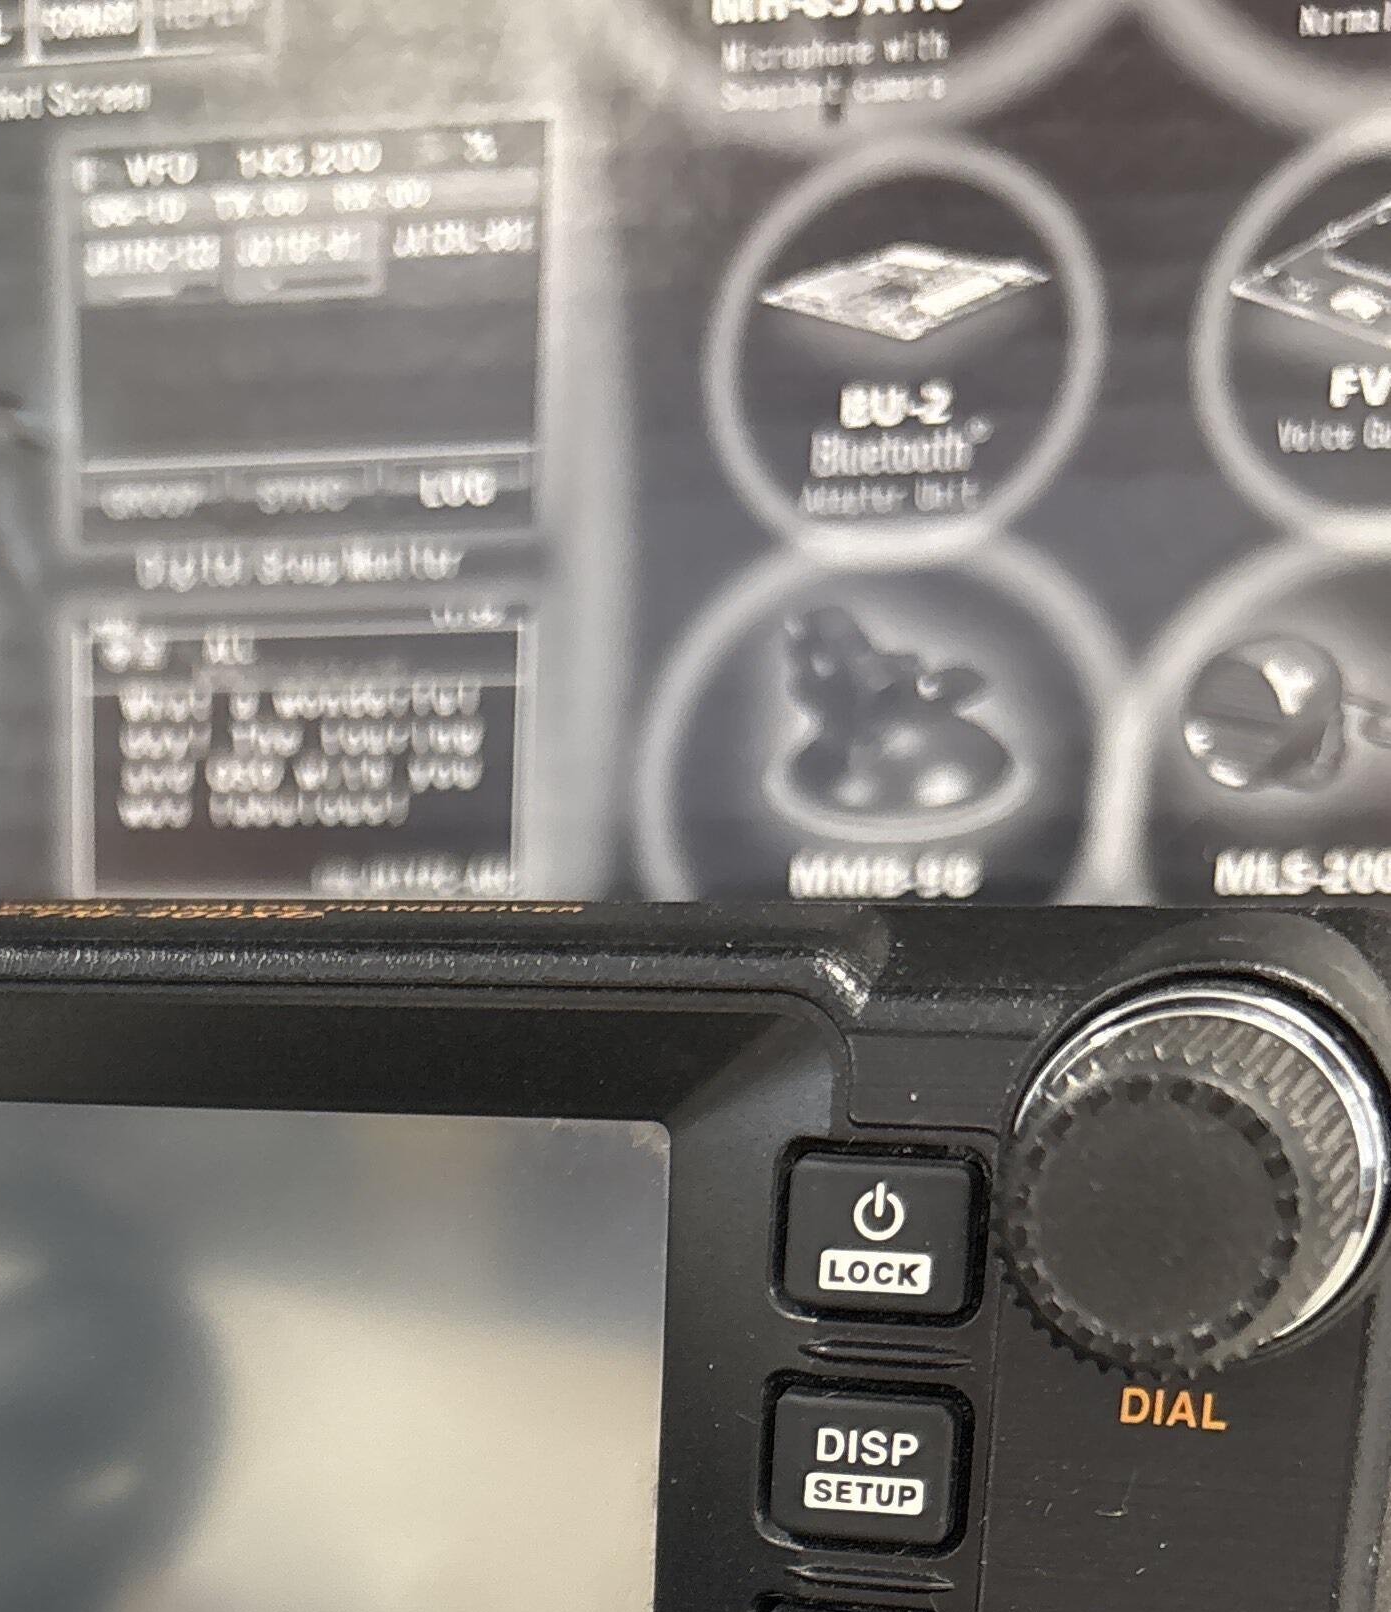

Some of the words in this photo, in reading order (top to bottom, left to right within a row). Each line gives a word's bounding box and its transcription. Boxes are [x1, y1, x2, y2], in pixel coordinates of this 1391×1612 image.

[839, 378, 953, 429] BU-2
[827, 1259, 920, 1288] LOCK
[1119, 1386, 1229, 1431] DIAL
[815, 1427, 919, 1468] DISP
[812, 1480, 918, 1508] SETUP
